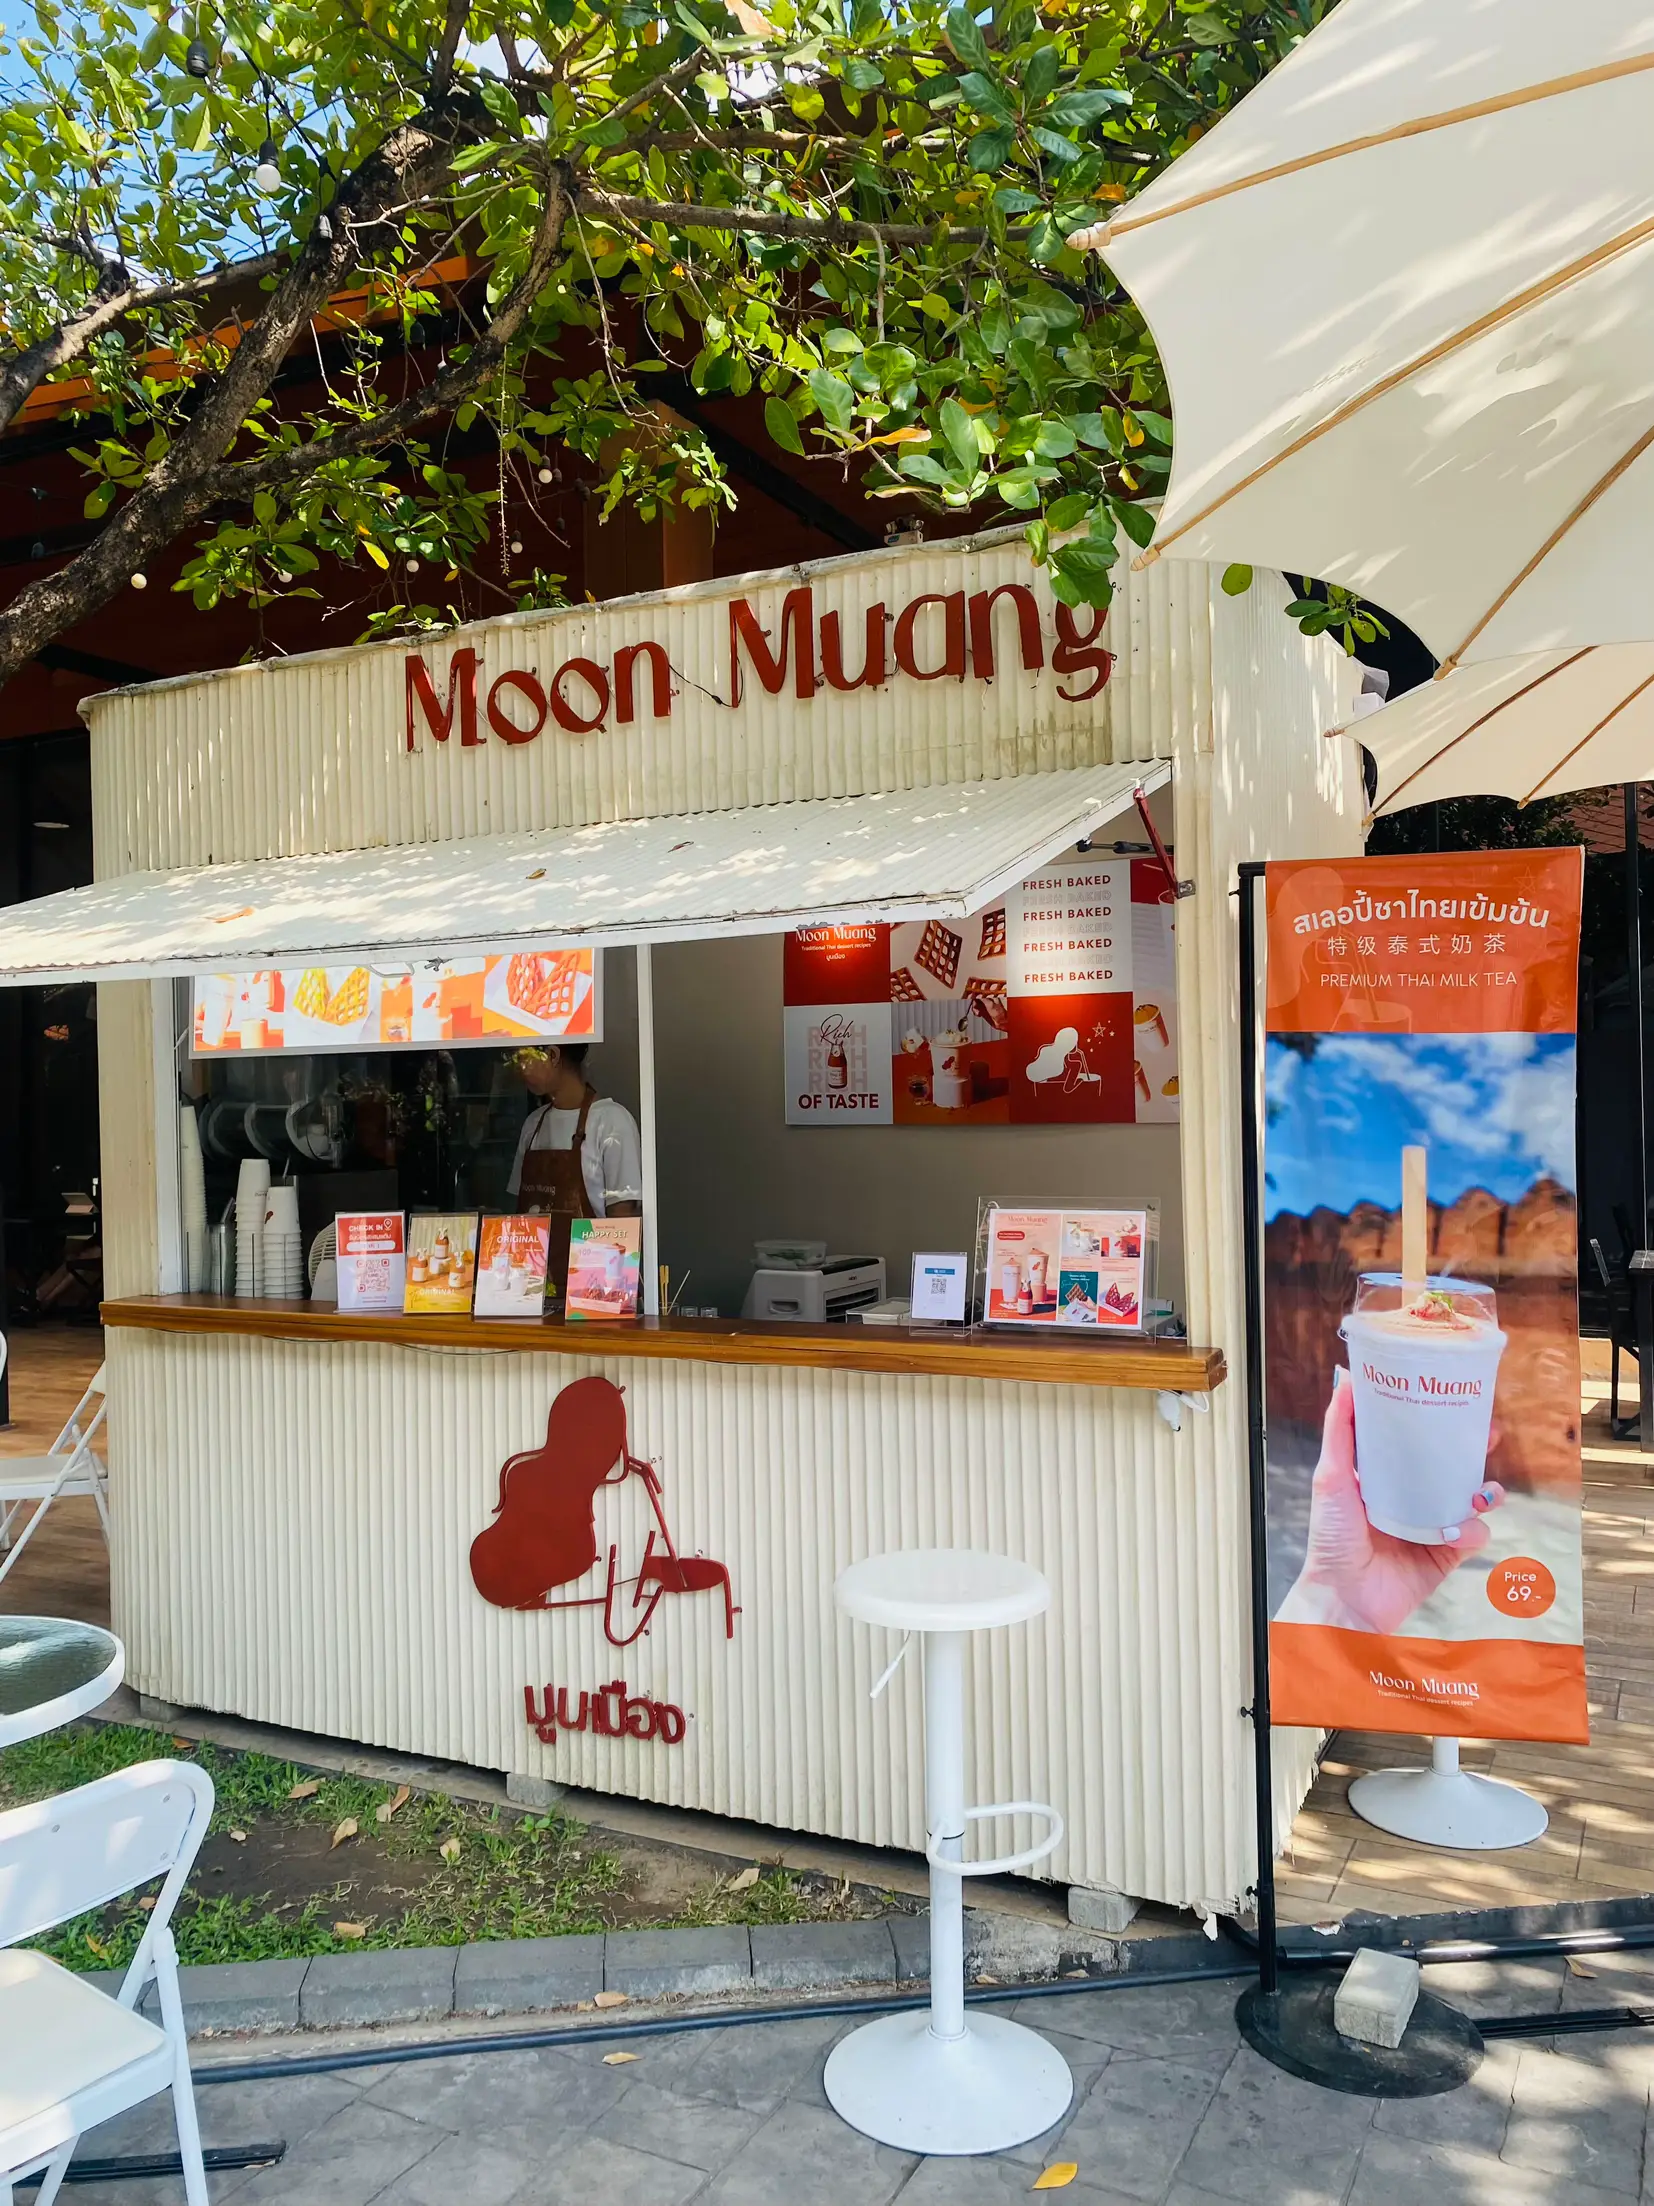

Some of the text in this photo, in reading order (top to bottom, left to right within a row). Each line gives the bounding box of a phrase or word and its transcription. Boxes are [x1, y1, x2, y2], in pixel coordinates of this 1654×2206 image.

[405, 583, 1113, 753] Moon Muang
[1023, 875, 1111, 891] FRESH BAKED
[1023, 906, 1112, 921] FRESH BAKED
[796, 927, 876, 943] Moon Muang
[1024, 938, 1112, 952] FRESH BAKED
[1327, 933, 1506, 956] 特级泰式奶茶
[1024, 970, 1113, 983] FRESH BAKED
[1321, 971, 1518, 988] PREMIUM THAI MILK TEA
[820, 1013, 854, 1045] Rich
[798, 1093, 879, 1109] OF TASTE
[348, 1224, 374, 1232] CHECK
[582, 1230, 628, 1240] HAPPY SET
[496, 1235, 539, 1243] ORIGINAL
[1362, 1362, 1482, 1398] Moon Muang
[1405, 1397, 1420, 1405] Thai
[1504, 1571, 1537, 1583] Price
[1506, 1586, 1542, 1602] 69.-
[1369, 1670, 1480, 1700] Moon Muang
[1377, 1689, 1474, 1708] Traditional Thai dessert recipes
[524, 1679, 687, 1744] มูนเมือง
